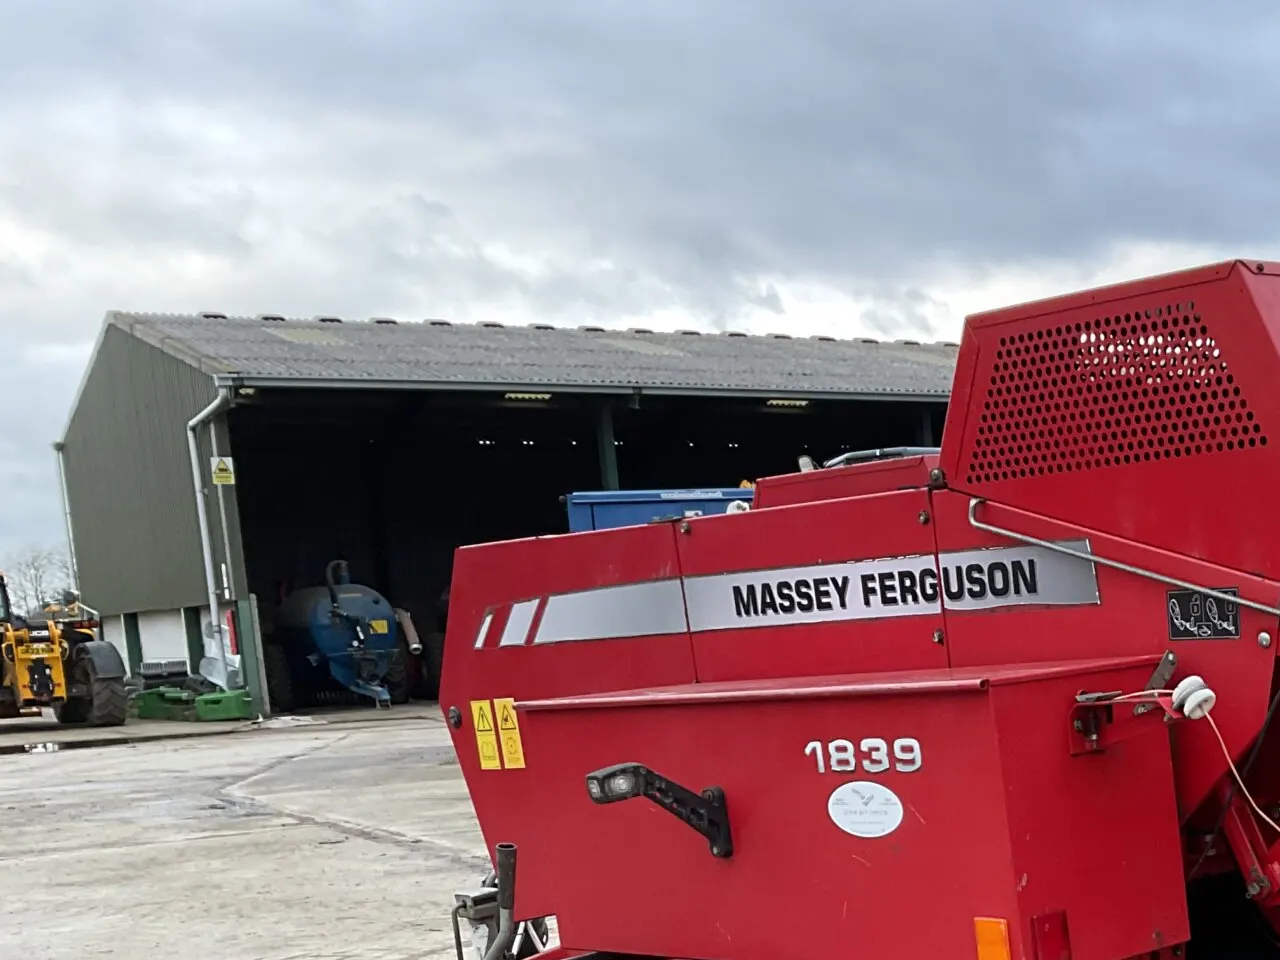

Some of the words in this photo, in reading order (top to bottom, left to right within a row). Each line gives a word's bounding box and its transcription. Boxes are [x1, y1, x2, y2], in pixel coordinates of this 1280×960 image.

[733, 575, 849, 618] MASSEY
[860, 558, 1038, 608] FERGUSON
[804, 737, 922, 774] 1839
